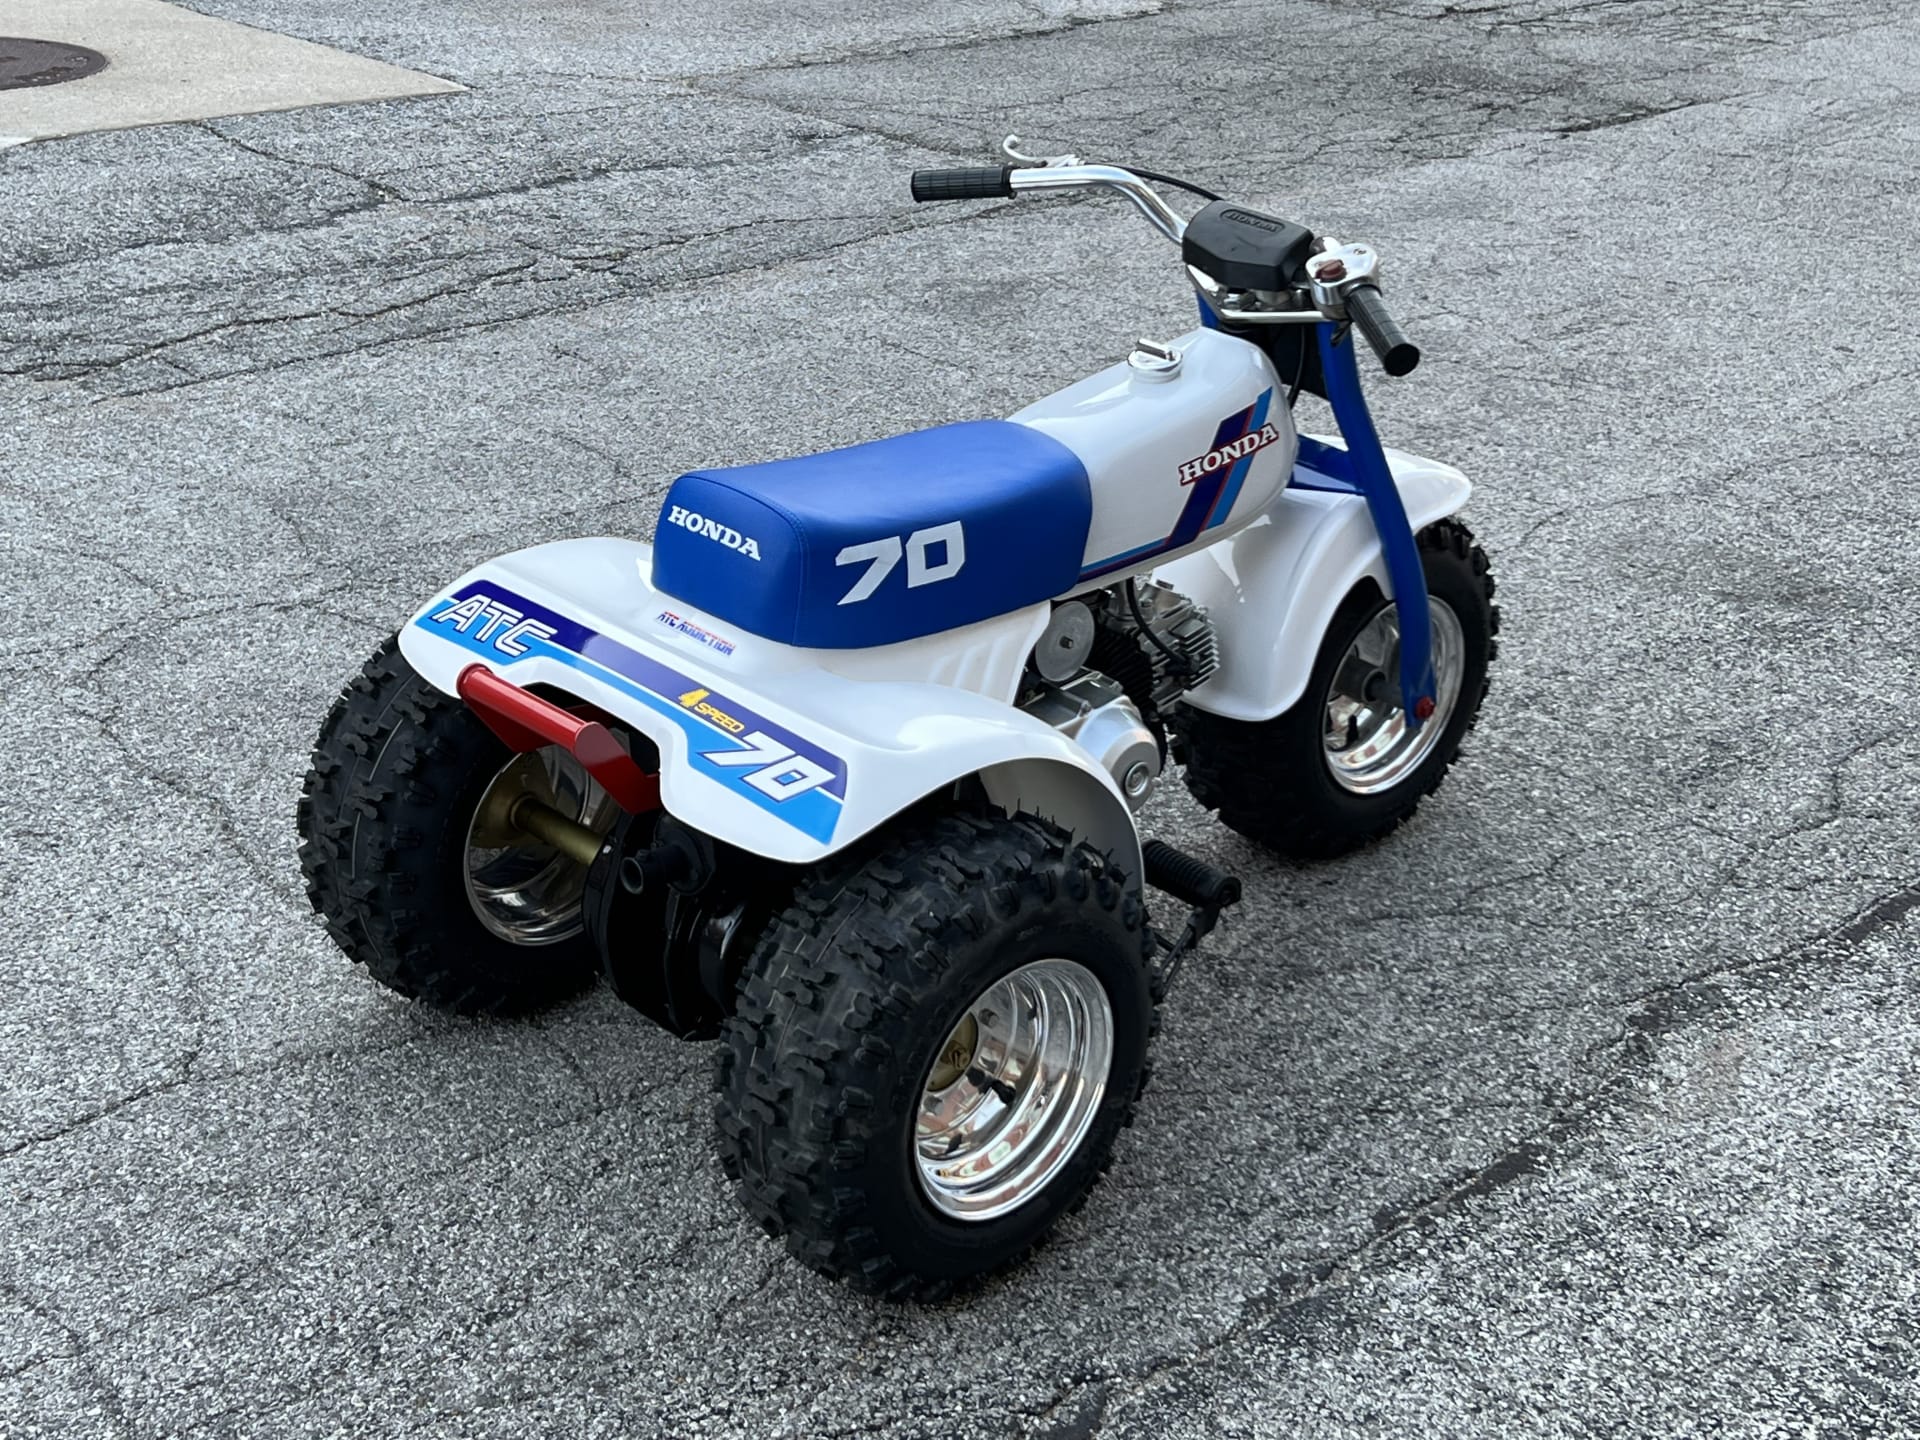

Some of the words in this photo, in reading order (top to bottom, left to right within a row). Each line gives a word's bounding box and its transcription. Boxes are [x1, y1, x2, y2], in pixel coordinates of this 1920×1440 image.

[1179, 423, 1279, 485] HONDA
[667, 505, 761, 561] HONDA
[835, 520, 966, 606] 70
[431, 593, 558, 658] ATC
[656, 611, 680, 628] ATC
[676, 620, 737, 656] ADDICTION
[678, 688, 710, 708] 4
[694, 702, 745, 734] SPEED
[699, 730, 838, 803] 70
